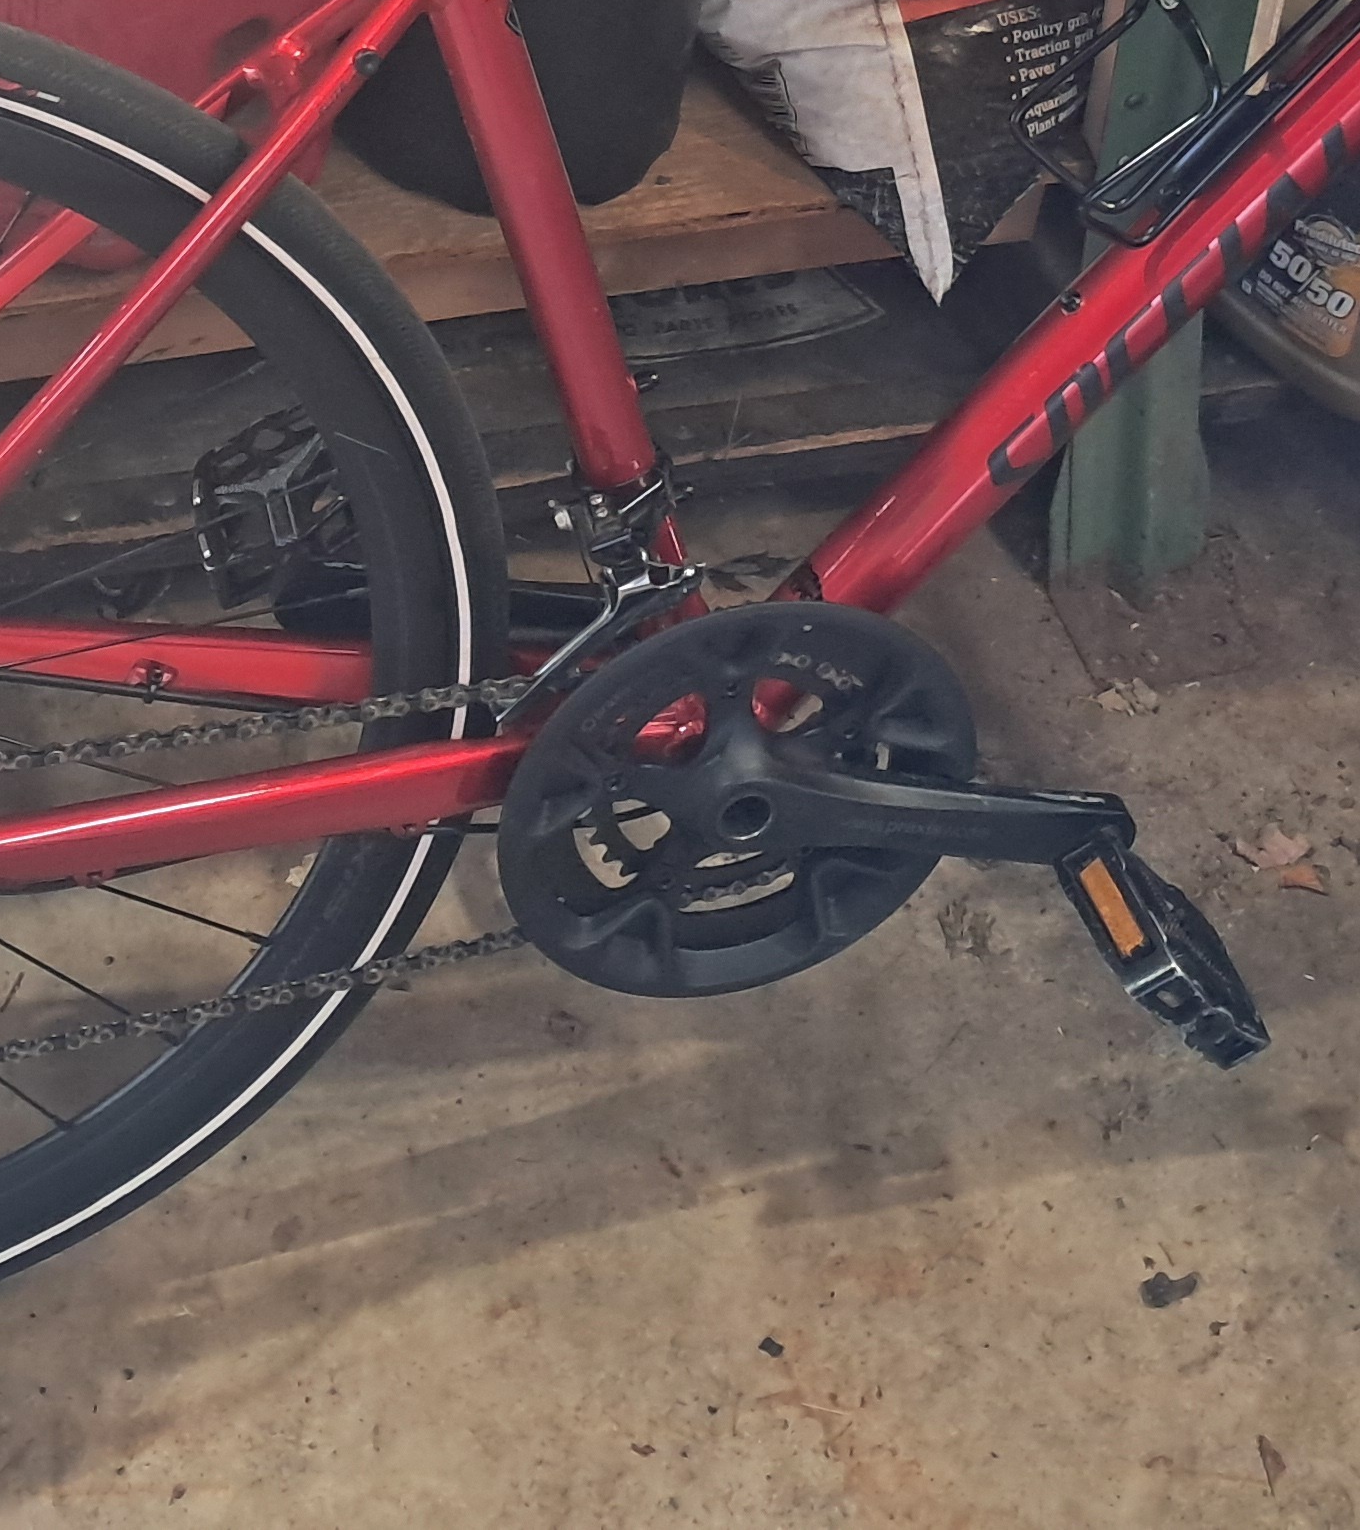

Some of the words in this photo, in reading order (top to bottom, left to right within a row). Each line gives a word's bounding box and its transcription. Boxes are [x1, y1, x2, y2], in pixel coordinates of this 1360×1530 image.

[996, 5, 1042, 27] USES:
[1012, 22, 1063, 44] Poultry
[1014, 38, 1071, 63] Traction
[1018, 62, 1056, 82] Paver
[1026, 115, 1056, 138] Plant
[1269, 239, 1356, 319] 50/50
